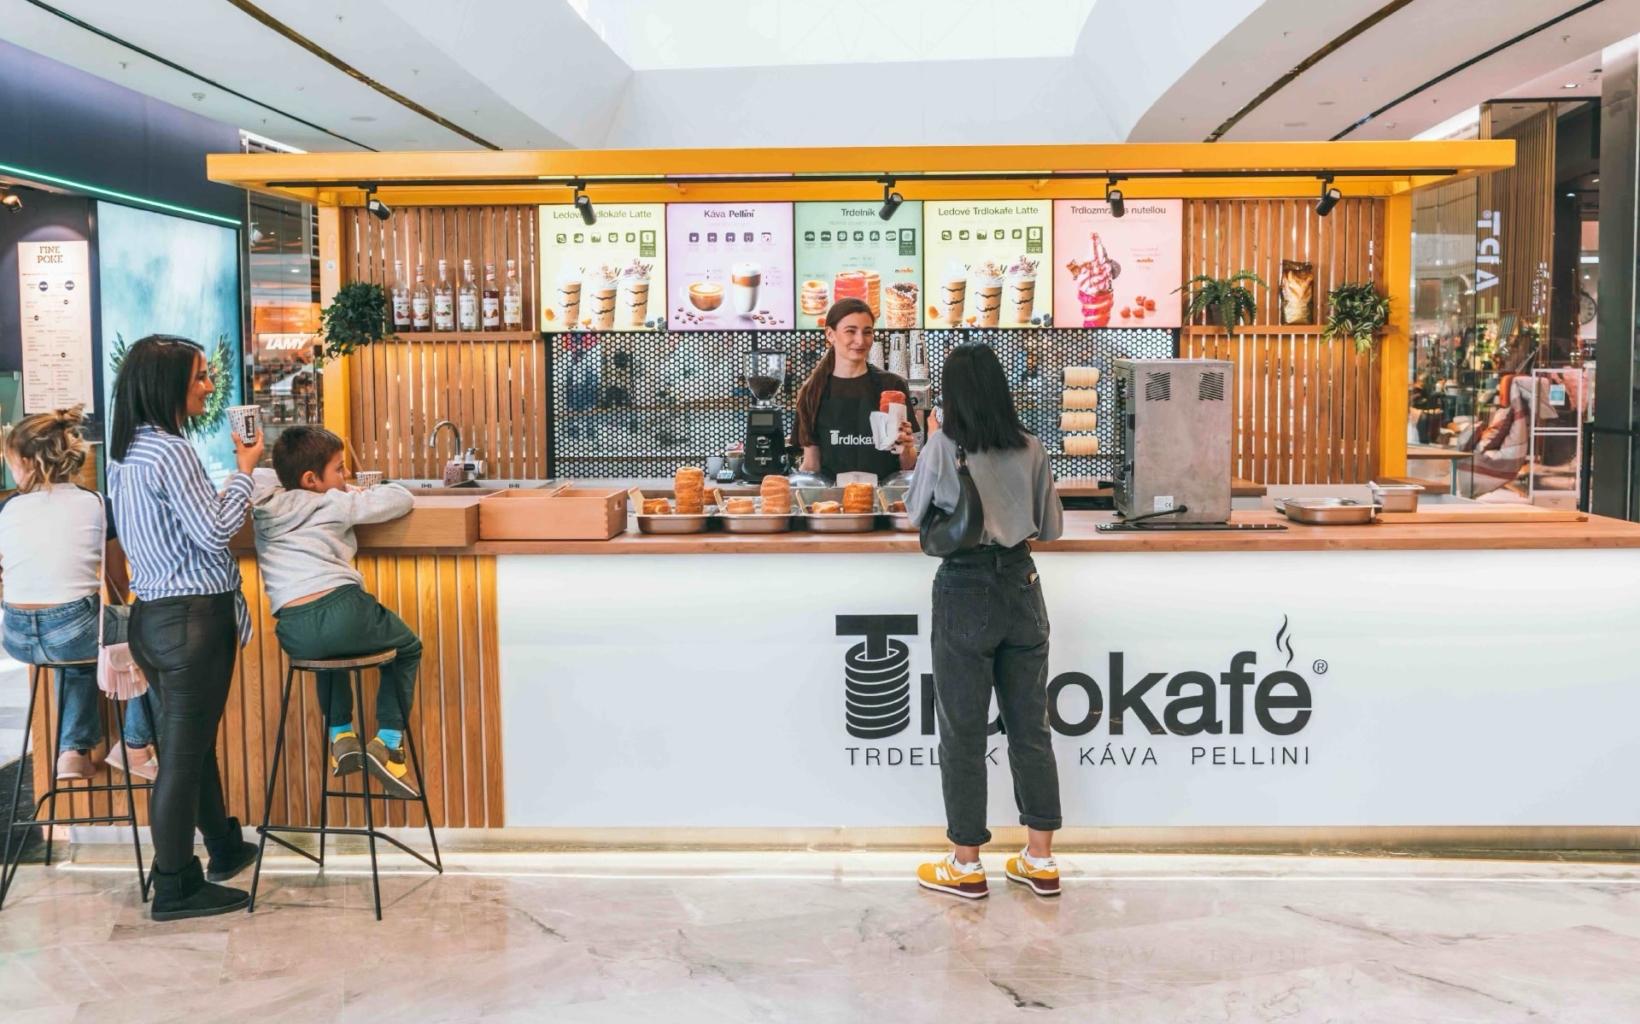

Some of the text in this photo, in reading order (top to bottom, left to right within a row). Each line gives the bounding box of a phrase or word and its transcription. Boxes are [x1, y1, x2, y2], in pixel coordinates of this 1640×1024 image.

[553, 210, 583, 219] Ledov
[629, 210, 652, 218] Latte
[704, 209, 754, 218] Káva Pellini
[938, 206, 1039, 216] Ledové Trdlokafe Latte
[1131, 206, 1166, 214] nutellou
[39, 246, 60, 254] FINE
[37, 255, 63, 264] POKE
[265, 338, 309, 350] LAMY
[1079, 742, 1158, 766] KÁVA
[1191, 746, 1309, 766] PELLINI
